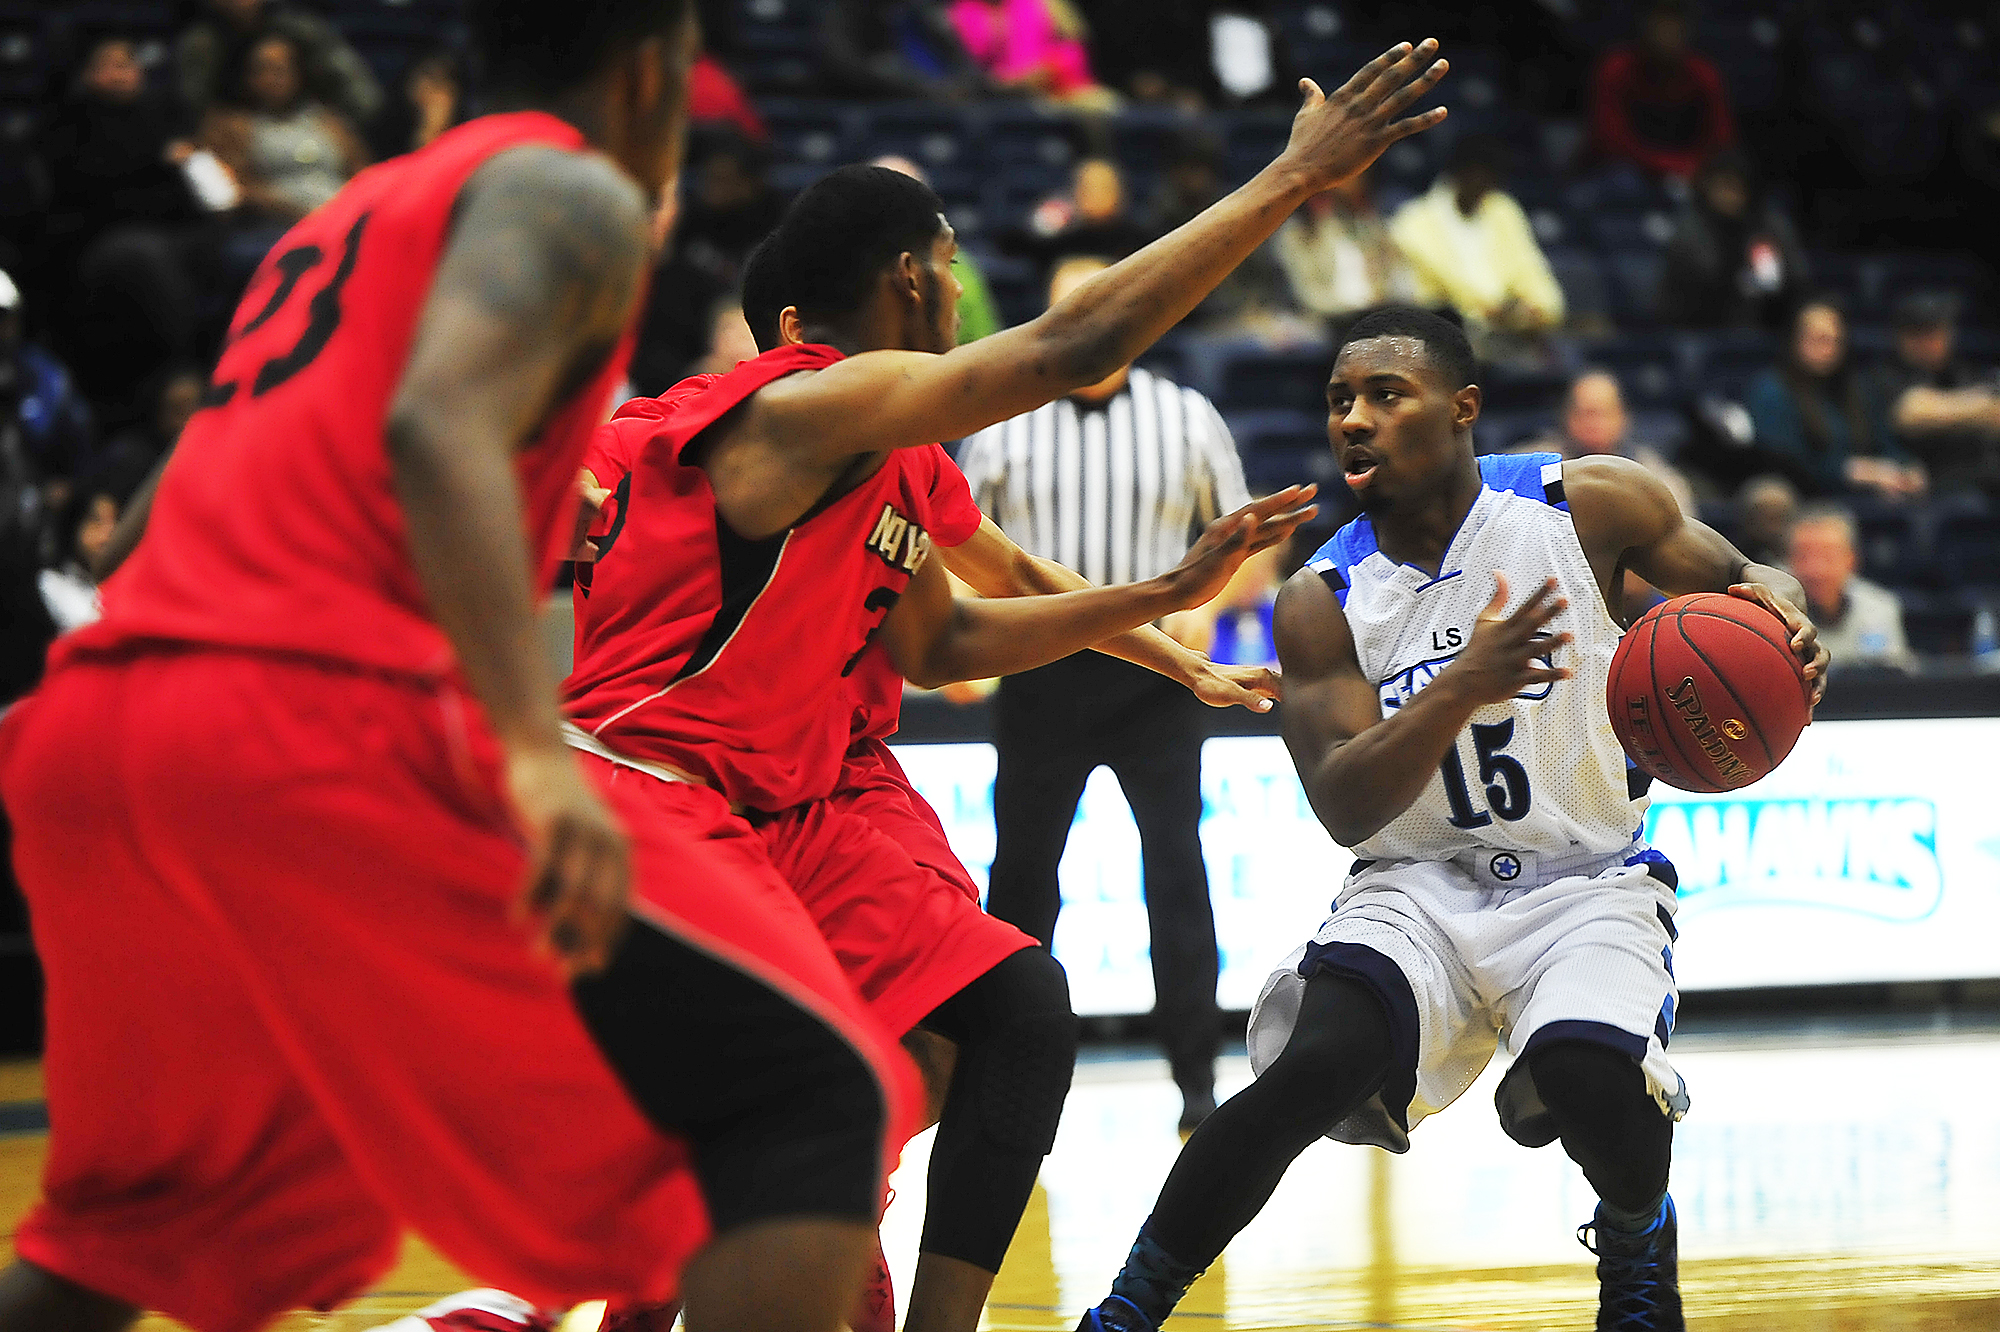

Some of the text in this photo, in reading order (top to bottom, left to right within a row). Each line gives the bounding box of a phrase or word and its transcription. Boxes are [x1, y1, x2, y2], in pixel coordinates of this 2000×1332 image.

[1431, 627, 1463, 652] LS
[1438, 716, 1532, 830] 15
[1663, 675, 1757, 785] SPALDING
